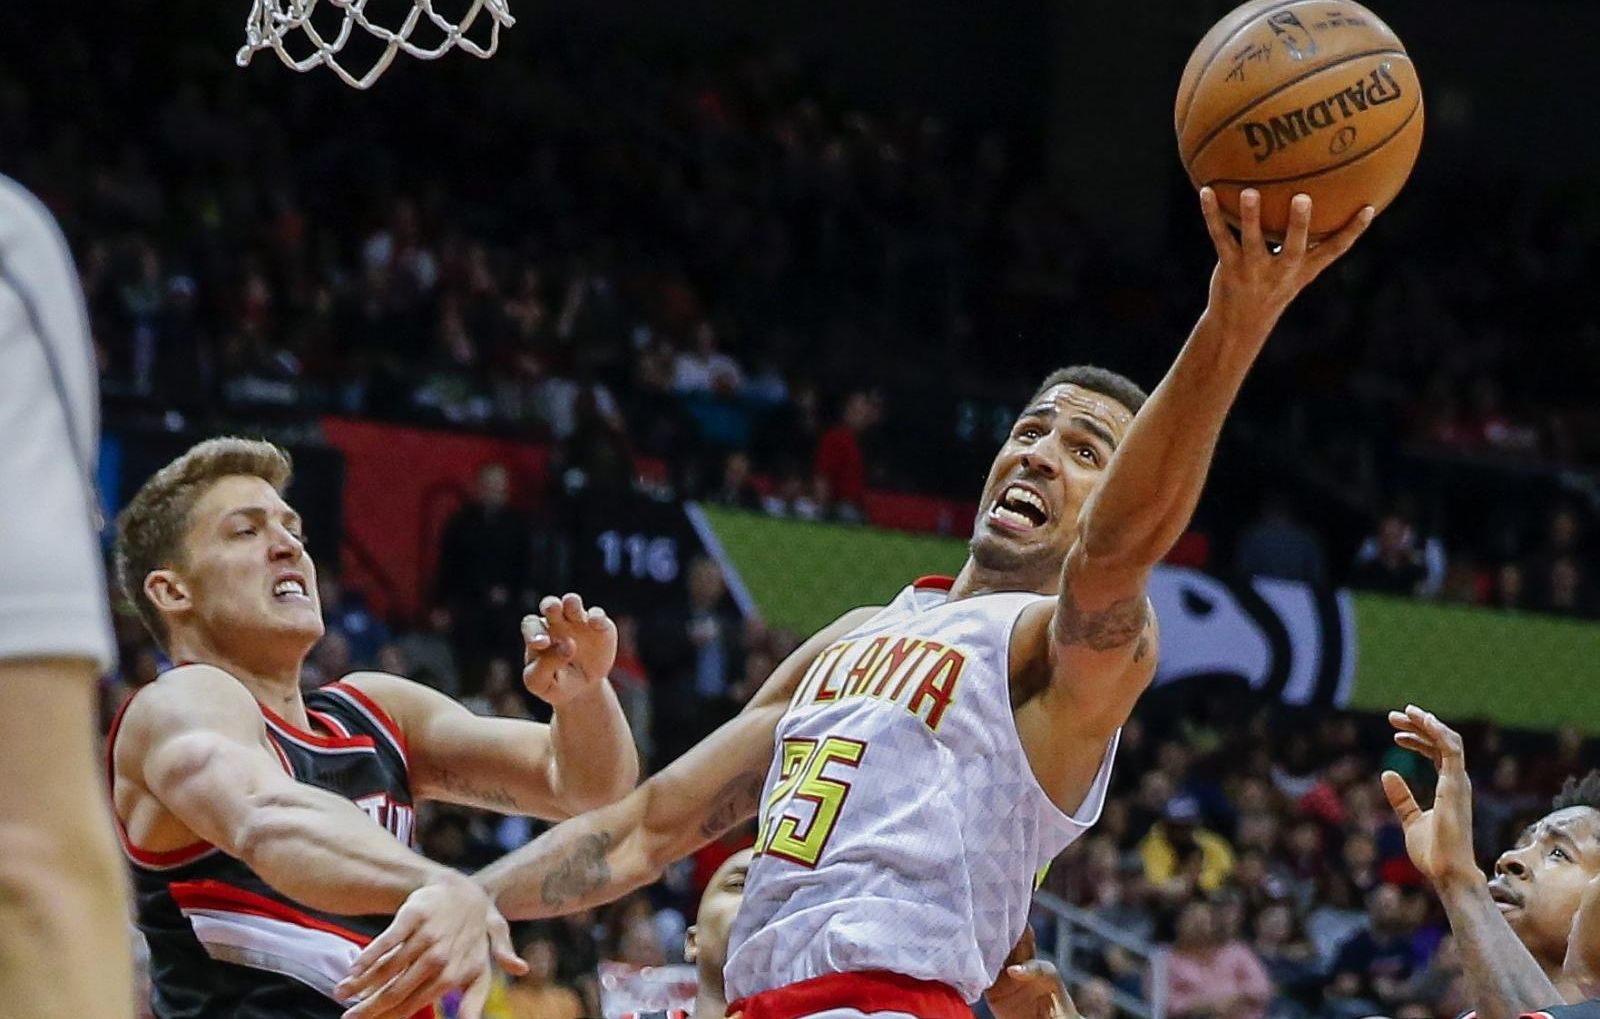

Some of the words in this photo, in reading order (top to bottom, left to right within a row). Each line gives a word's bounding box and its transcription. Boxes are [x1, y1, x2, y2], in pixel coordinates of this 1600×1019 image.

[1243, 61, 1401, 163] SPALDING
[597, 529, 678, 583] 116
[794, 635, 966, 734] TLANTA
